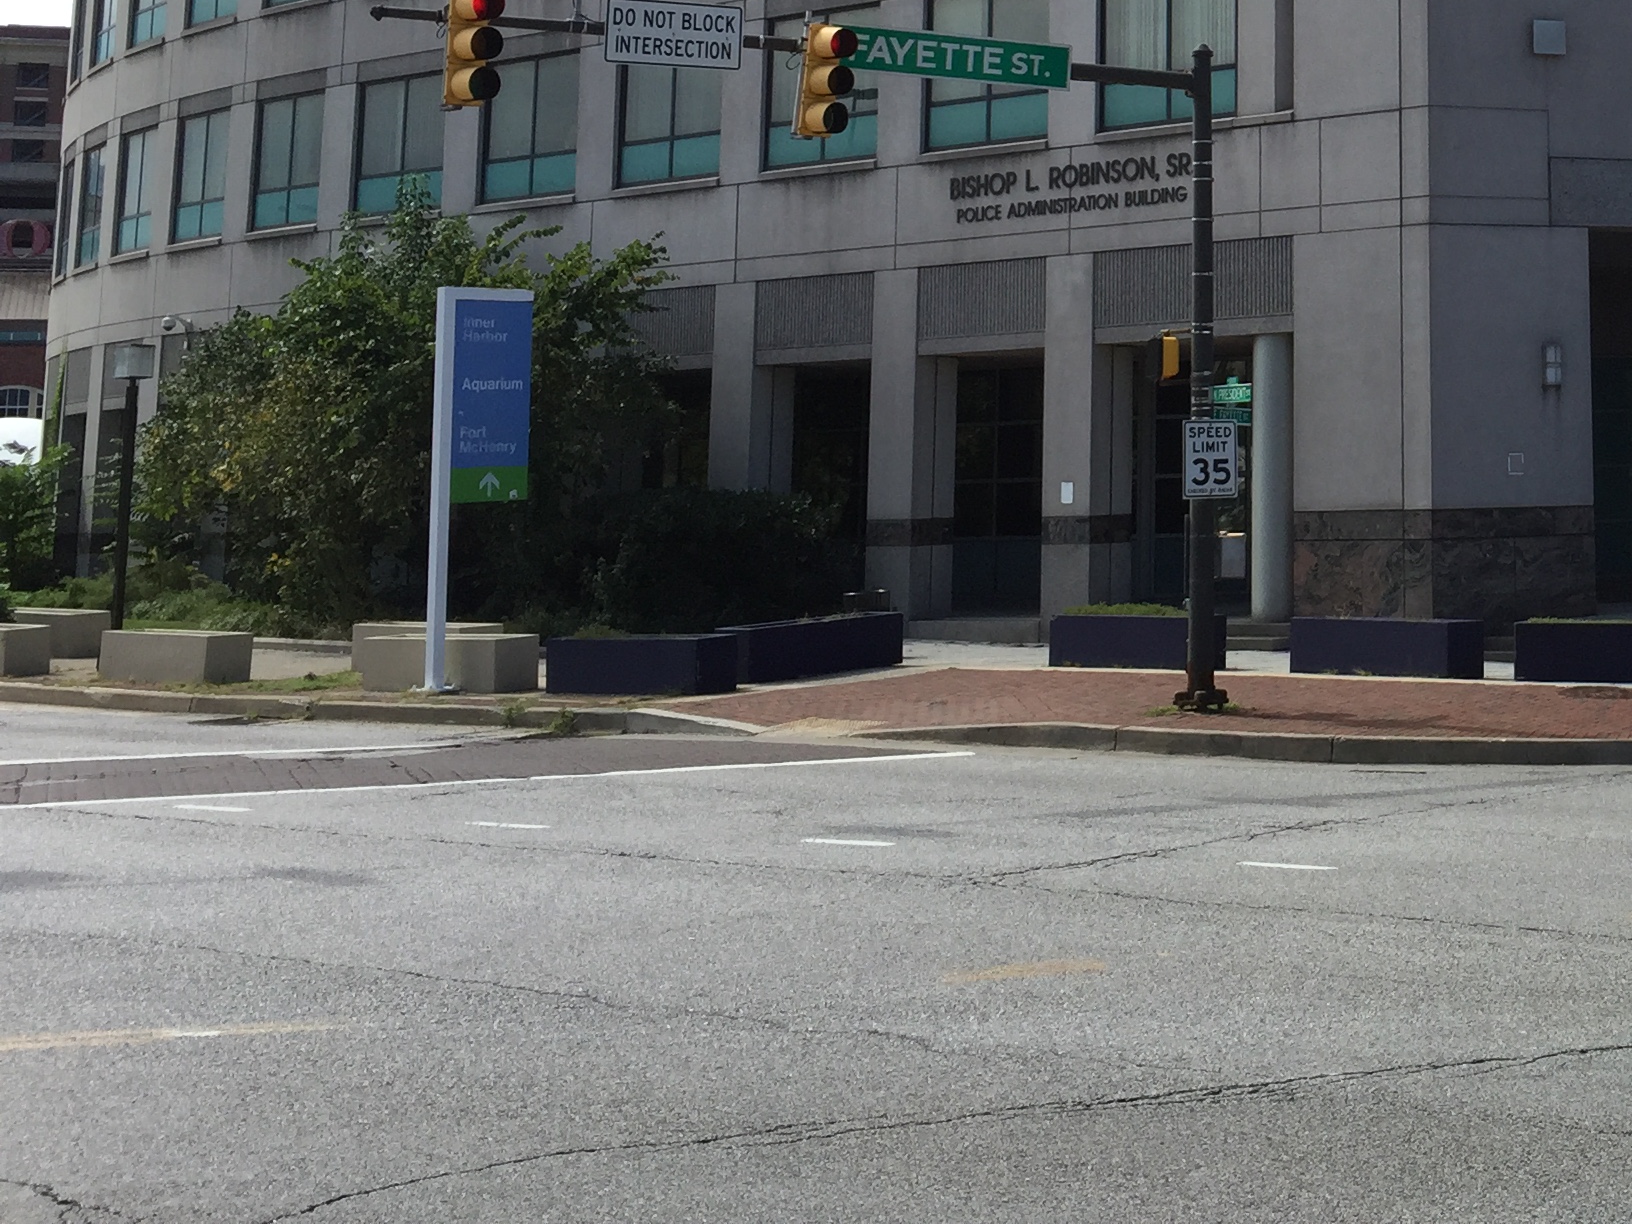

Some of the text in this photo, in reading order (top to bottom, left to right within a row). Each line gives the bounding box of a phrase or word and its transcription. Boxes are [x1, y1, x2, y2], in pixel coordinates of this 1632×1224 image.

[612, 7, 736, 33] DO NOT BLOCK
[615, 35, 732, 60] INTERSECTION
[849, 33, 1051, 78] FAYETTE ST.
[950, 171, 1018, 201] BISHOP
[1025, 168, 1040, 192] L.
[1049, 155, 1160, 190] ROBINSON,
[956, 185, 1188, 224] POLICE ADMINISTRATION BUILDING
[463, 316, 496, 328] Inner
[463, 329, 509, 343] Harbor
[461, 378, 523, 393] Aquarium
[459, 426, 487, 438] Fort
[1188, 426, 1232, 438] SPEED
[459, 441, 517, 455] McHenry
[1192, 441, 1228, 453] LIMIT
[1191, 458, 1231, 486] 35
